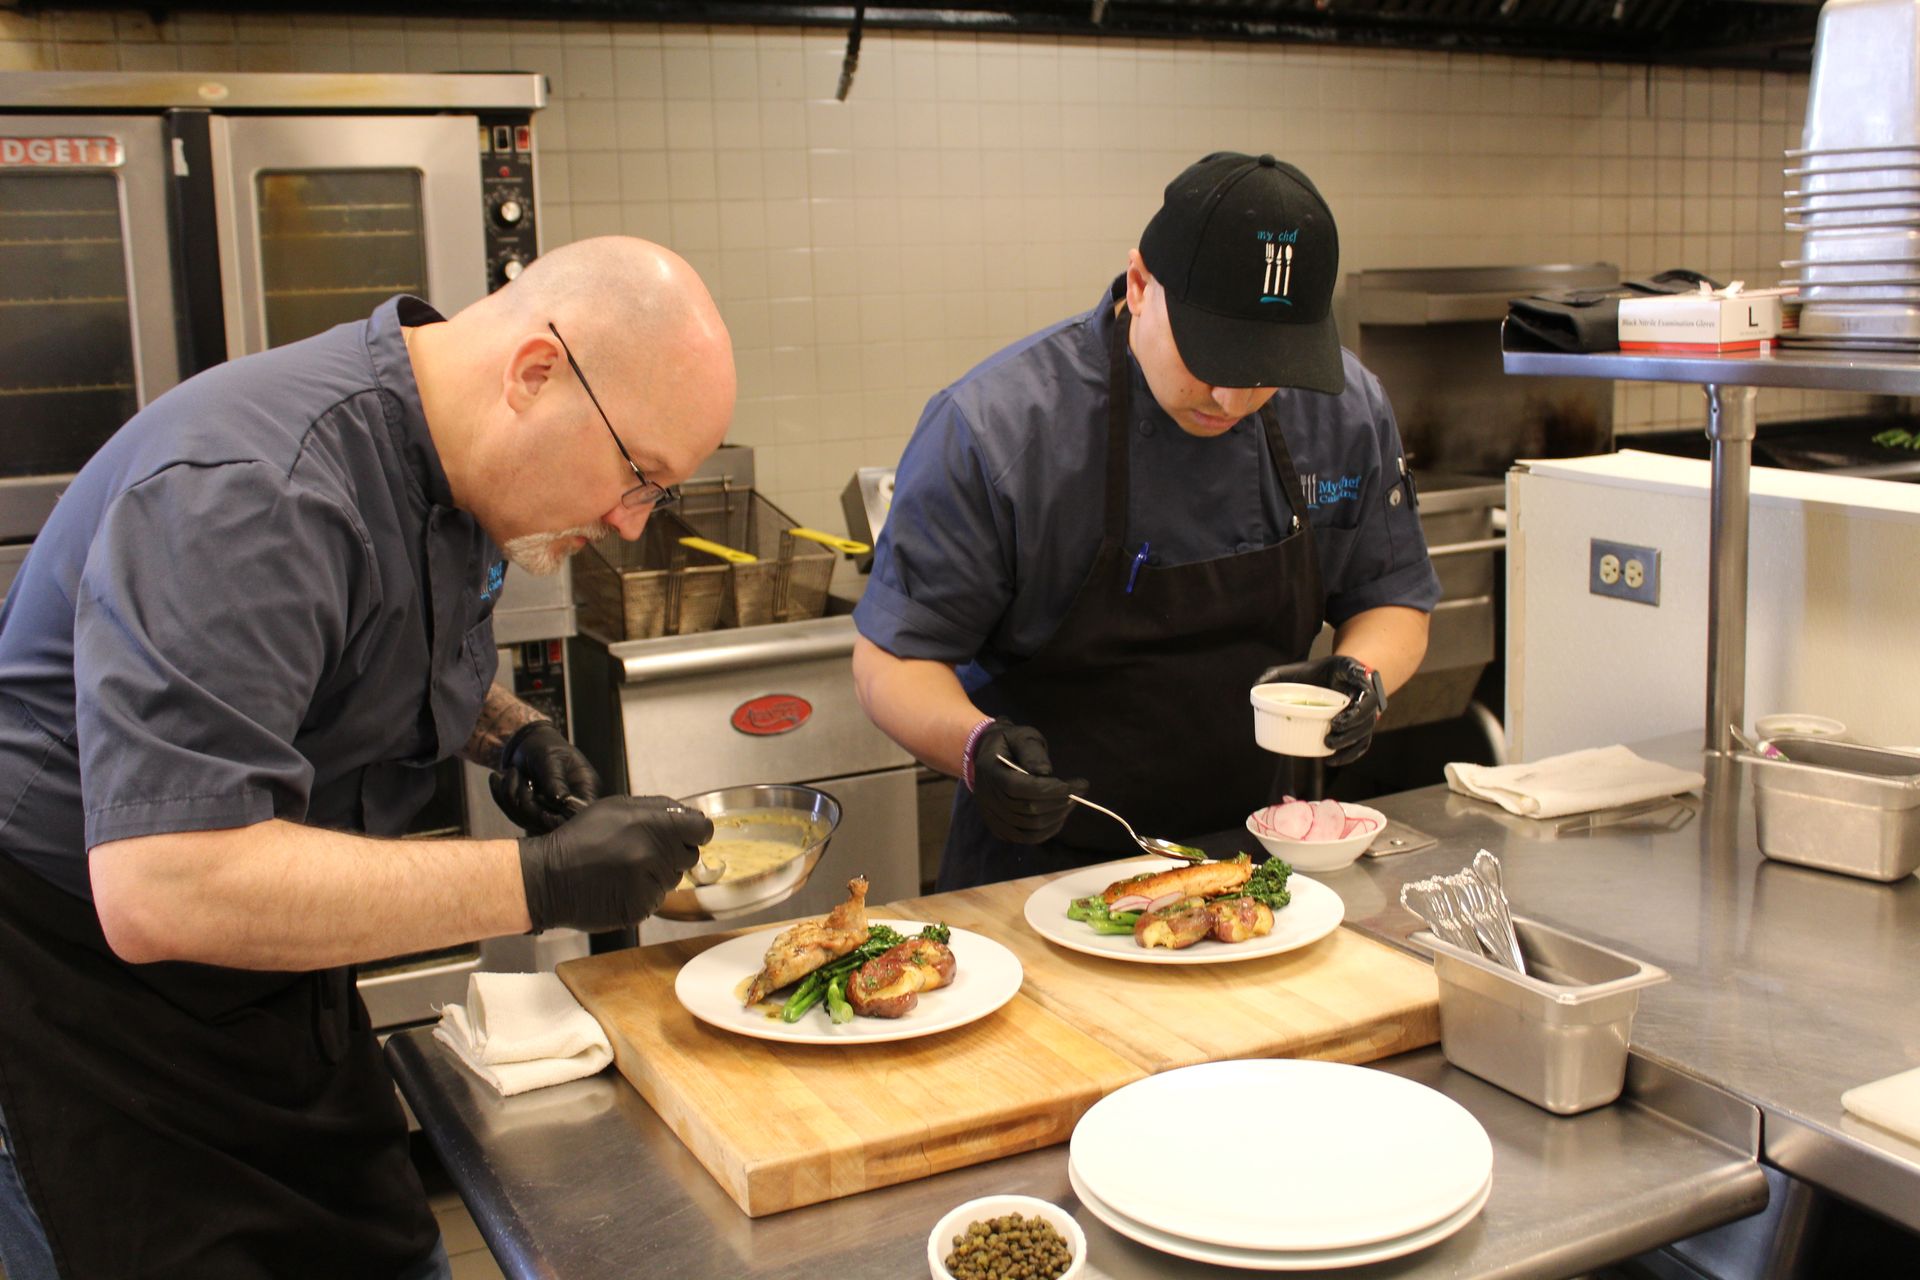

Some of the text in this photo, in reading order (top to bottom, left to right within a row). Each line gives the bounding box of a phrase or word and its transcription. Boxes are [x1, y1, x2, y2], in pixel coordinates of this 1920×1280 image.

[3, 139, 109, 162] DGETT
[1257, 228, 1299, 244] my chef
[1748, 306, 1759, 327] L
[1319, 480, 1338, 496] My
